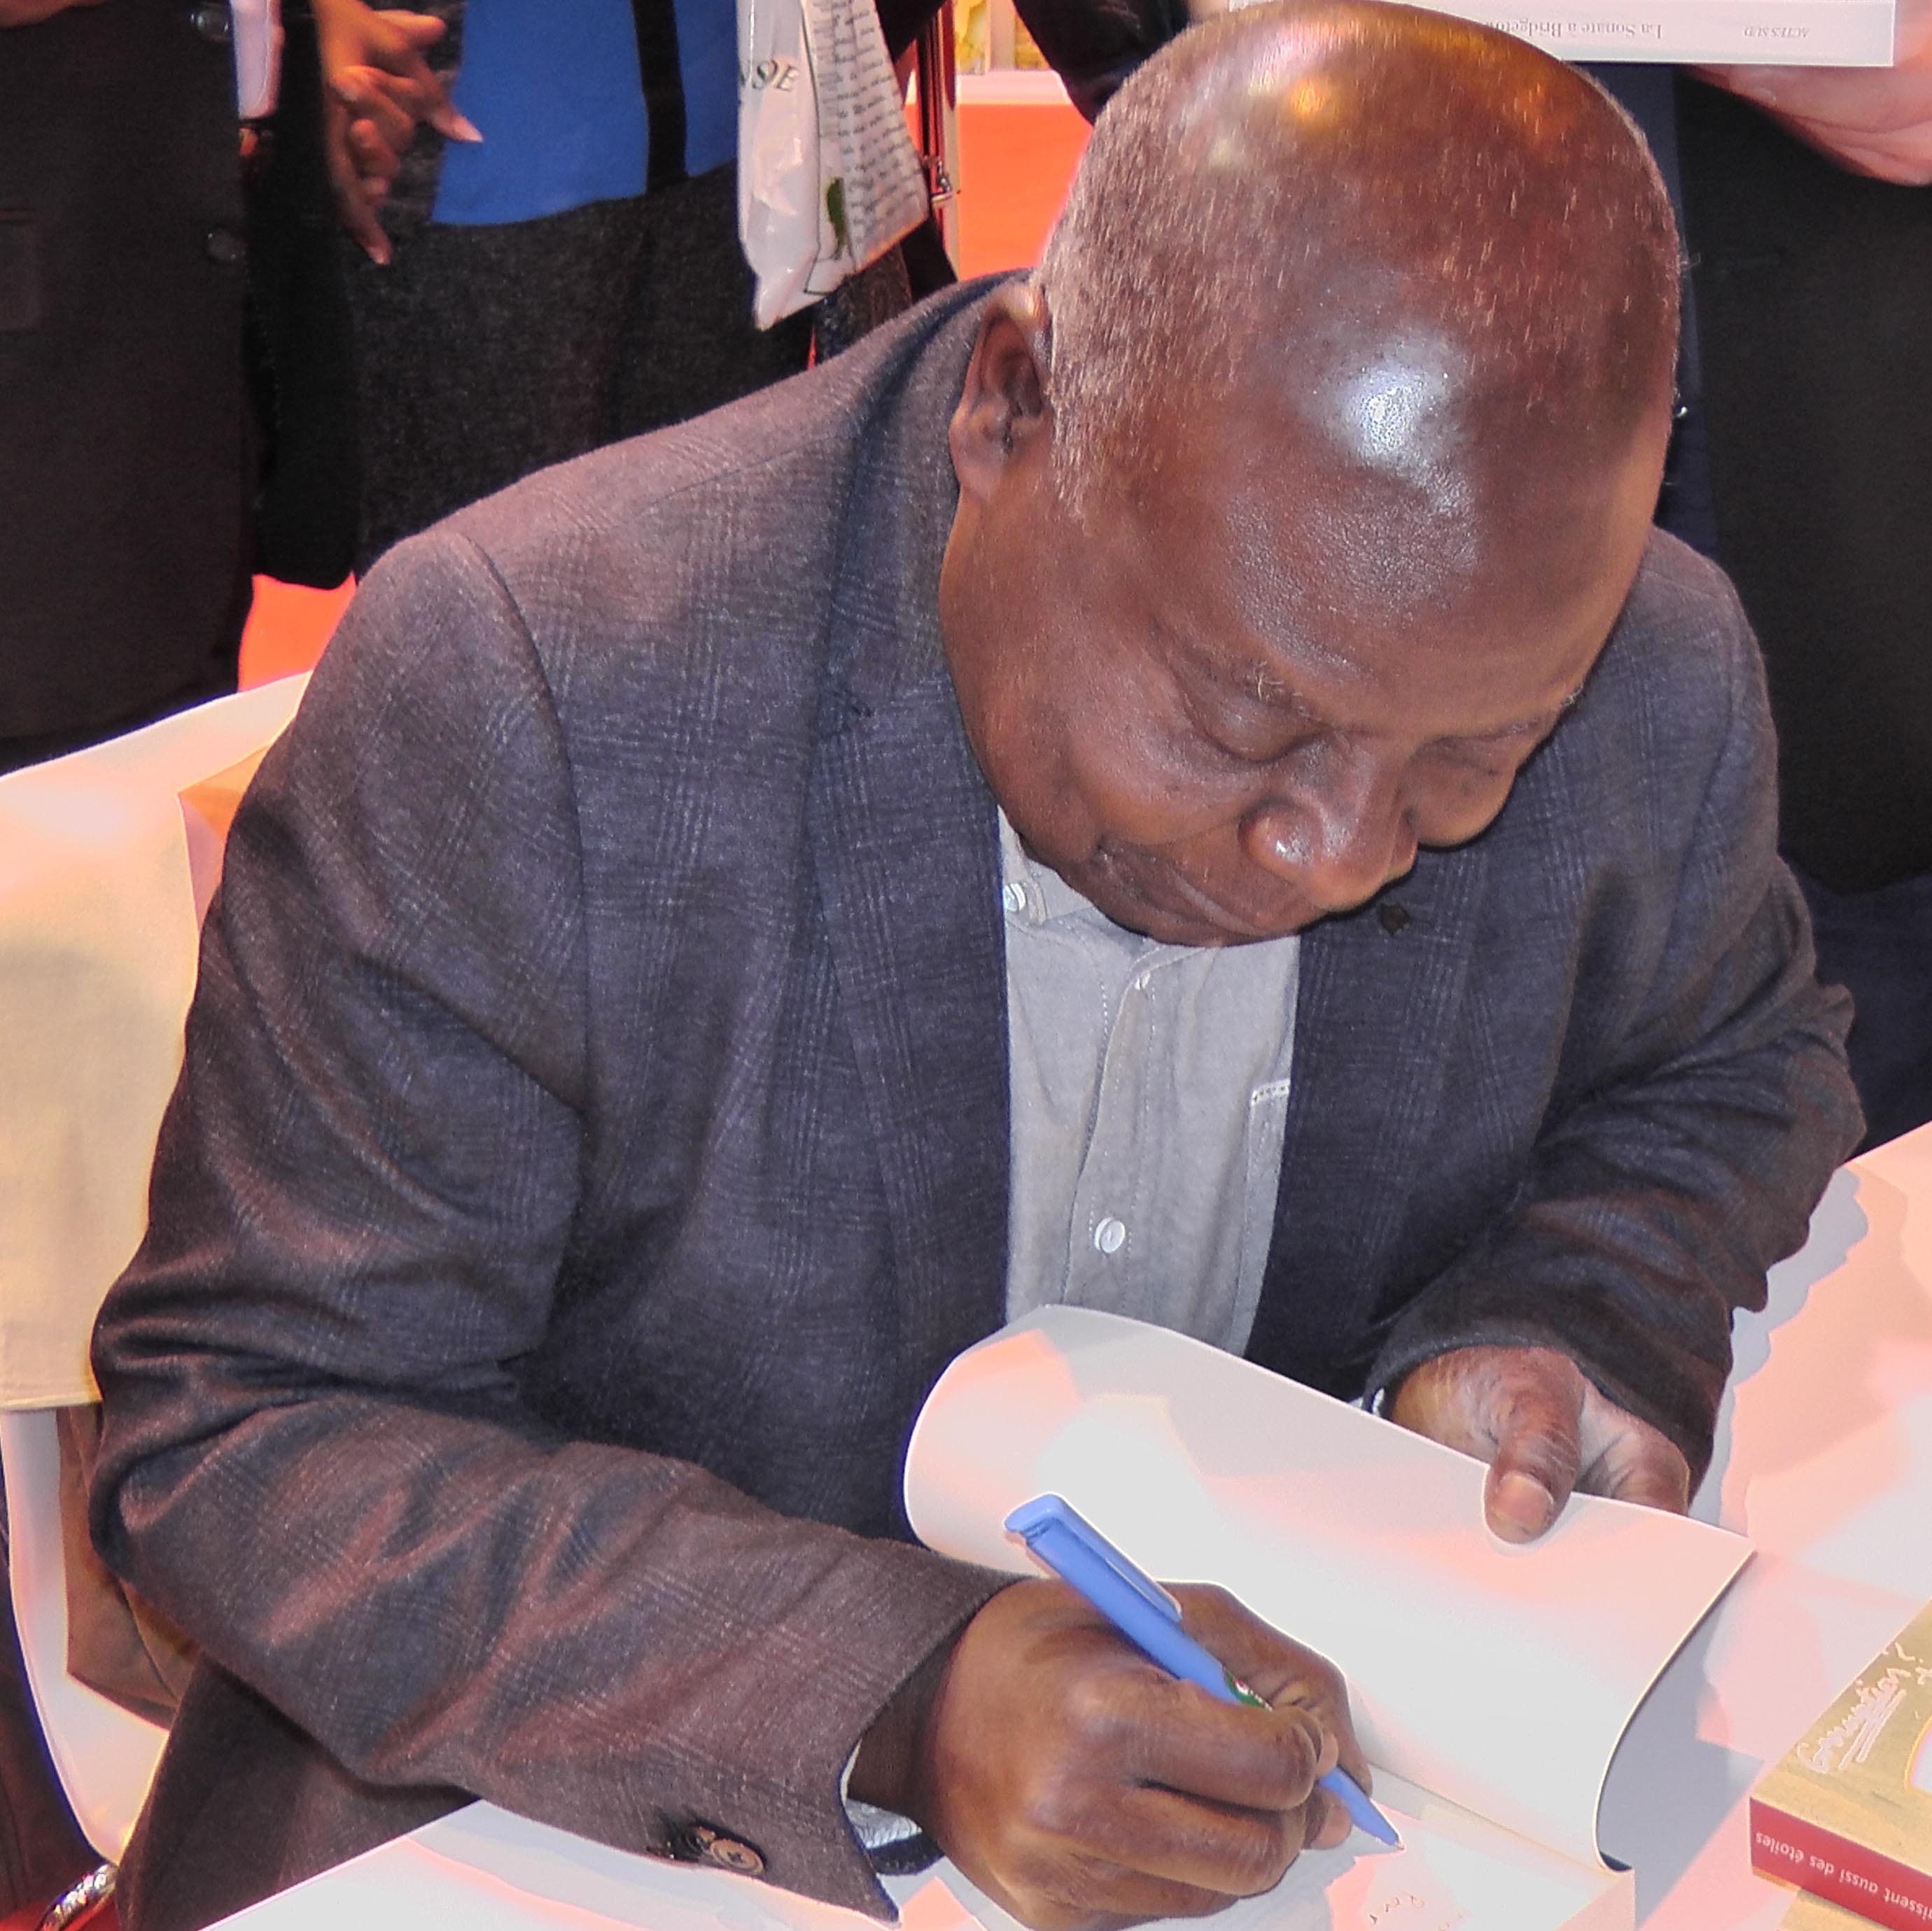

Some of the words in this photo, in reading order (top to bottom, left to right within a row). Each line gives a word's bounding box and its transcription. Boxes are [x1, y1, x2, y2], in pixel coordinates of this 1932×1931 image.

[1568, 22, 1576, 38] à
[1581, 22, 1636, 38] Sonate
[1641, 23, 1662, 38] La
[1743, 27, 1769, 37] SUD
[1770, 27, 1809, 38] ACTES
[1755, 1832, 1805, 1863] étoiles
[1809, 1855, 1835, 1876] des
[1839, 1868, 1879, 1894] aussi
